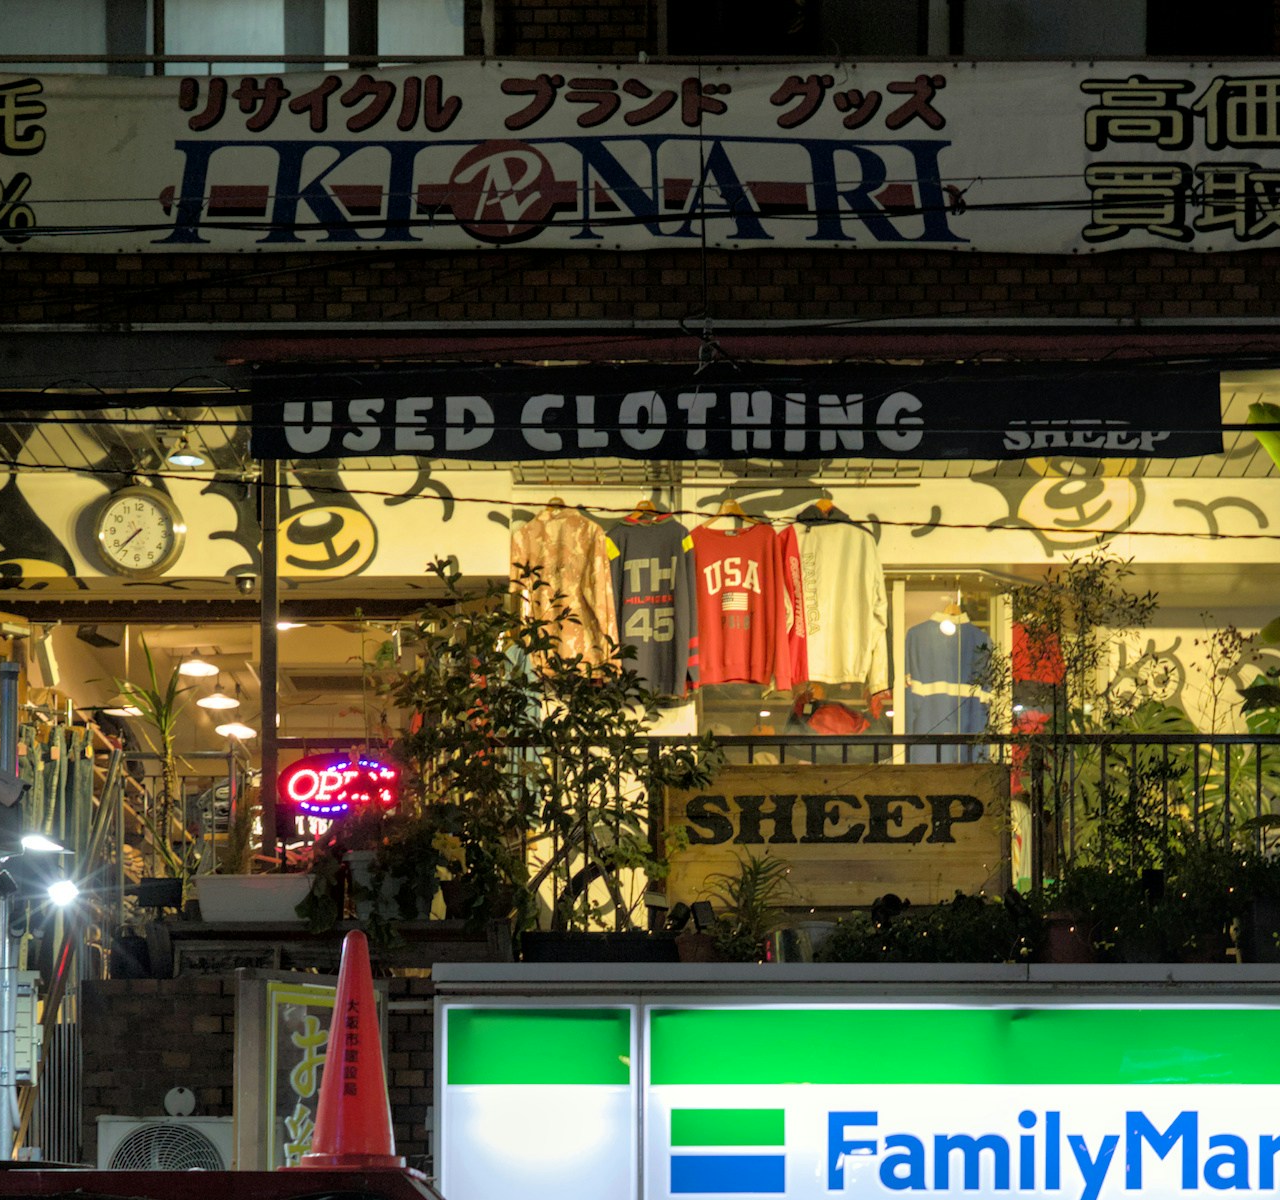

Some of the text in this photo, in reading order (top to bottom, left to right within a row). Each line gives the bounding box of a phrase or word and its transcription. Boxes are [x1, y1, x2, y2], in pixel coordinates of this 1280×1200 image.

[179, 74, 947, 132] リサイクル ブランド グッズ
[284, 392, 925, 455] USED CLOTHING
[1003, 420, 1171, 453] SHEEP
[624, 556, 677, 593] TH
[703, 557, 761, 595] USA
[802, 552, 820, 635] NAUTICA
[624, 607, 675, 643] 45
[287, 767, 396, 801] OP
[685, 793, 985, 845] SHEEP
